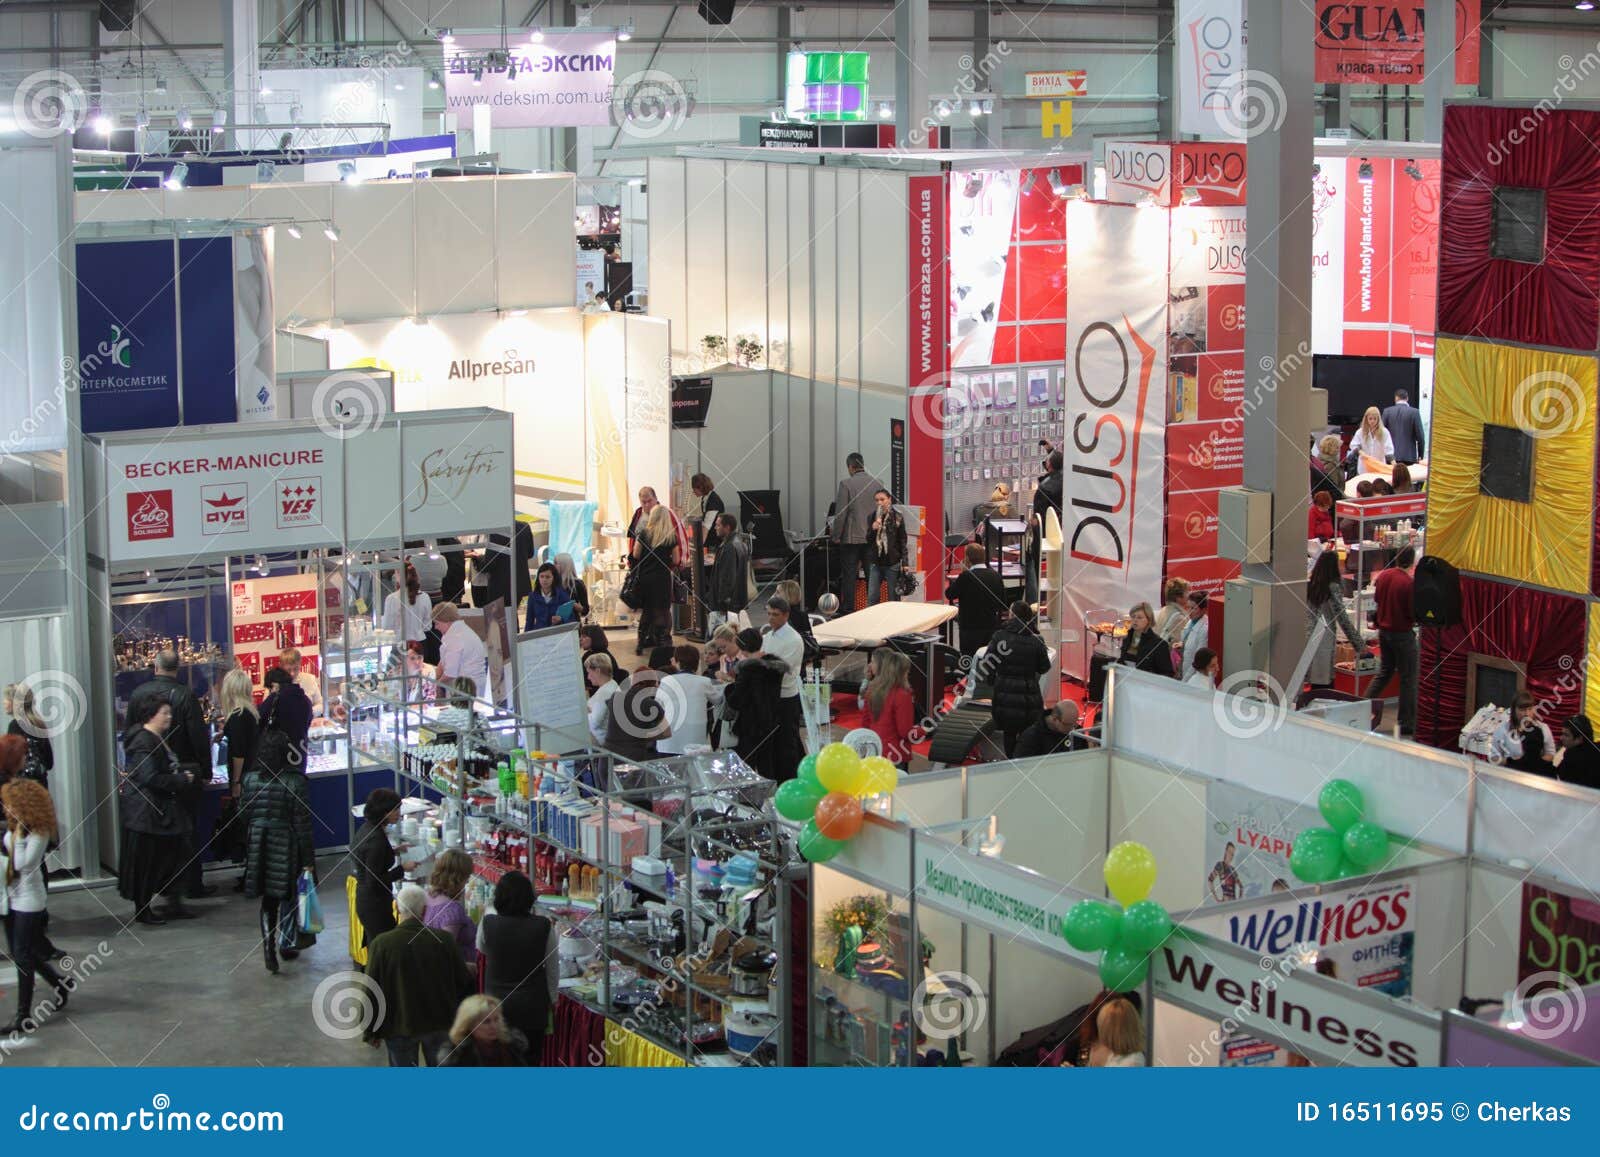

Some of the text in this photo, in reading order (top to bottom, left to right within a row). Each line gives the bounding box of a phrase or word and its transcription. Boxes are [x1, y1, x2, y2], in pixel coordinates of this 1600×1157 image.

[1032, 76, 1062, 88] ВИХІД
[1336, 64, 1374, 77] краса
[449, 89, 613, 108] www.deksim.com.ua
[1111, 150, 1165, 183] DUSO
[1181, 152, 1244, 184] DUSO
[920, 189, 932, 373] www.straza.com.ua
[448, 356, 536, 381] Allpresan
[1071, 321, 1129, 569] DUSO
[125, 449, 324, 479] BECKER-MANICURE
[206, 509, 245, 523] aya
[282, 498, 317, 516] YES
[1229, 890, 1411, 955] Wellness
[1163, 945, 1418, 1067] Wellness
